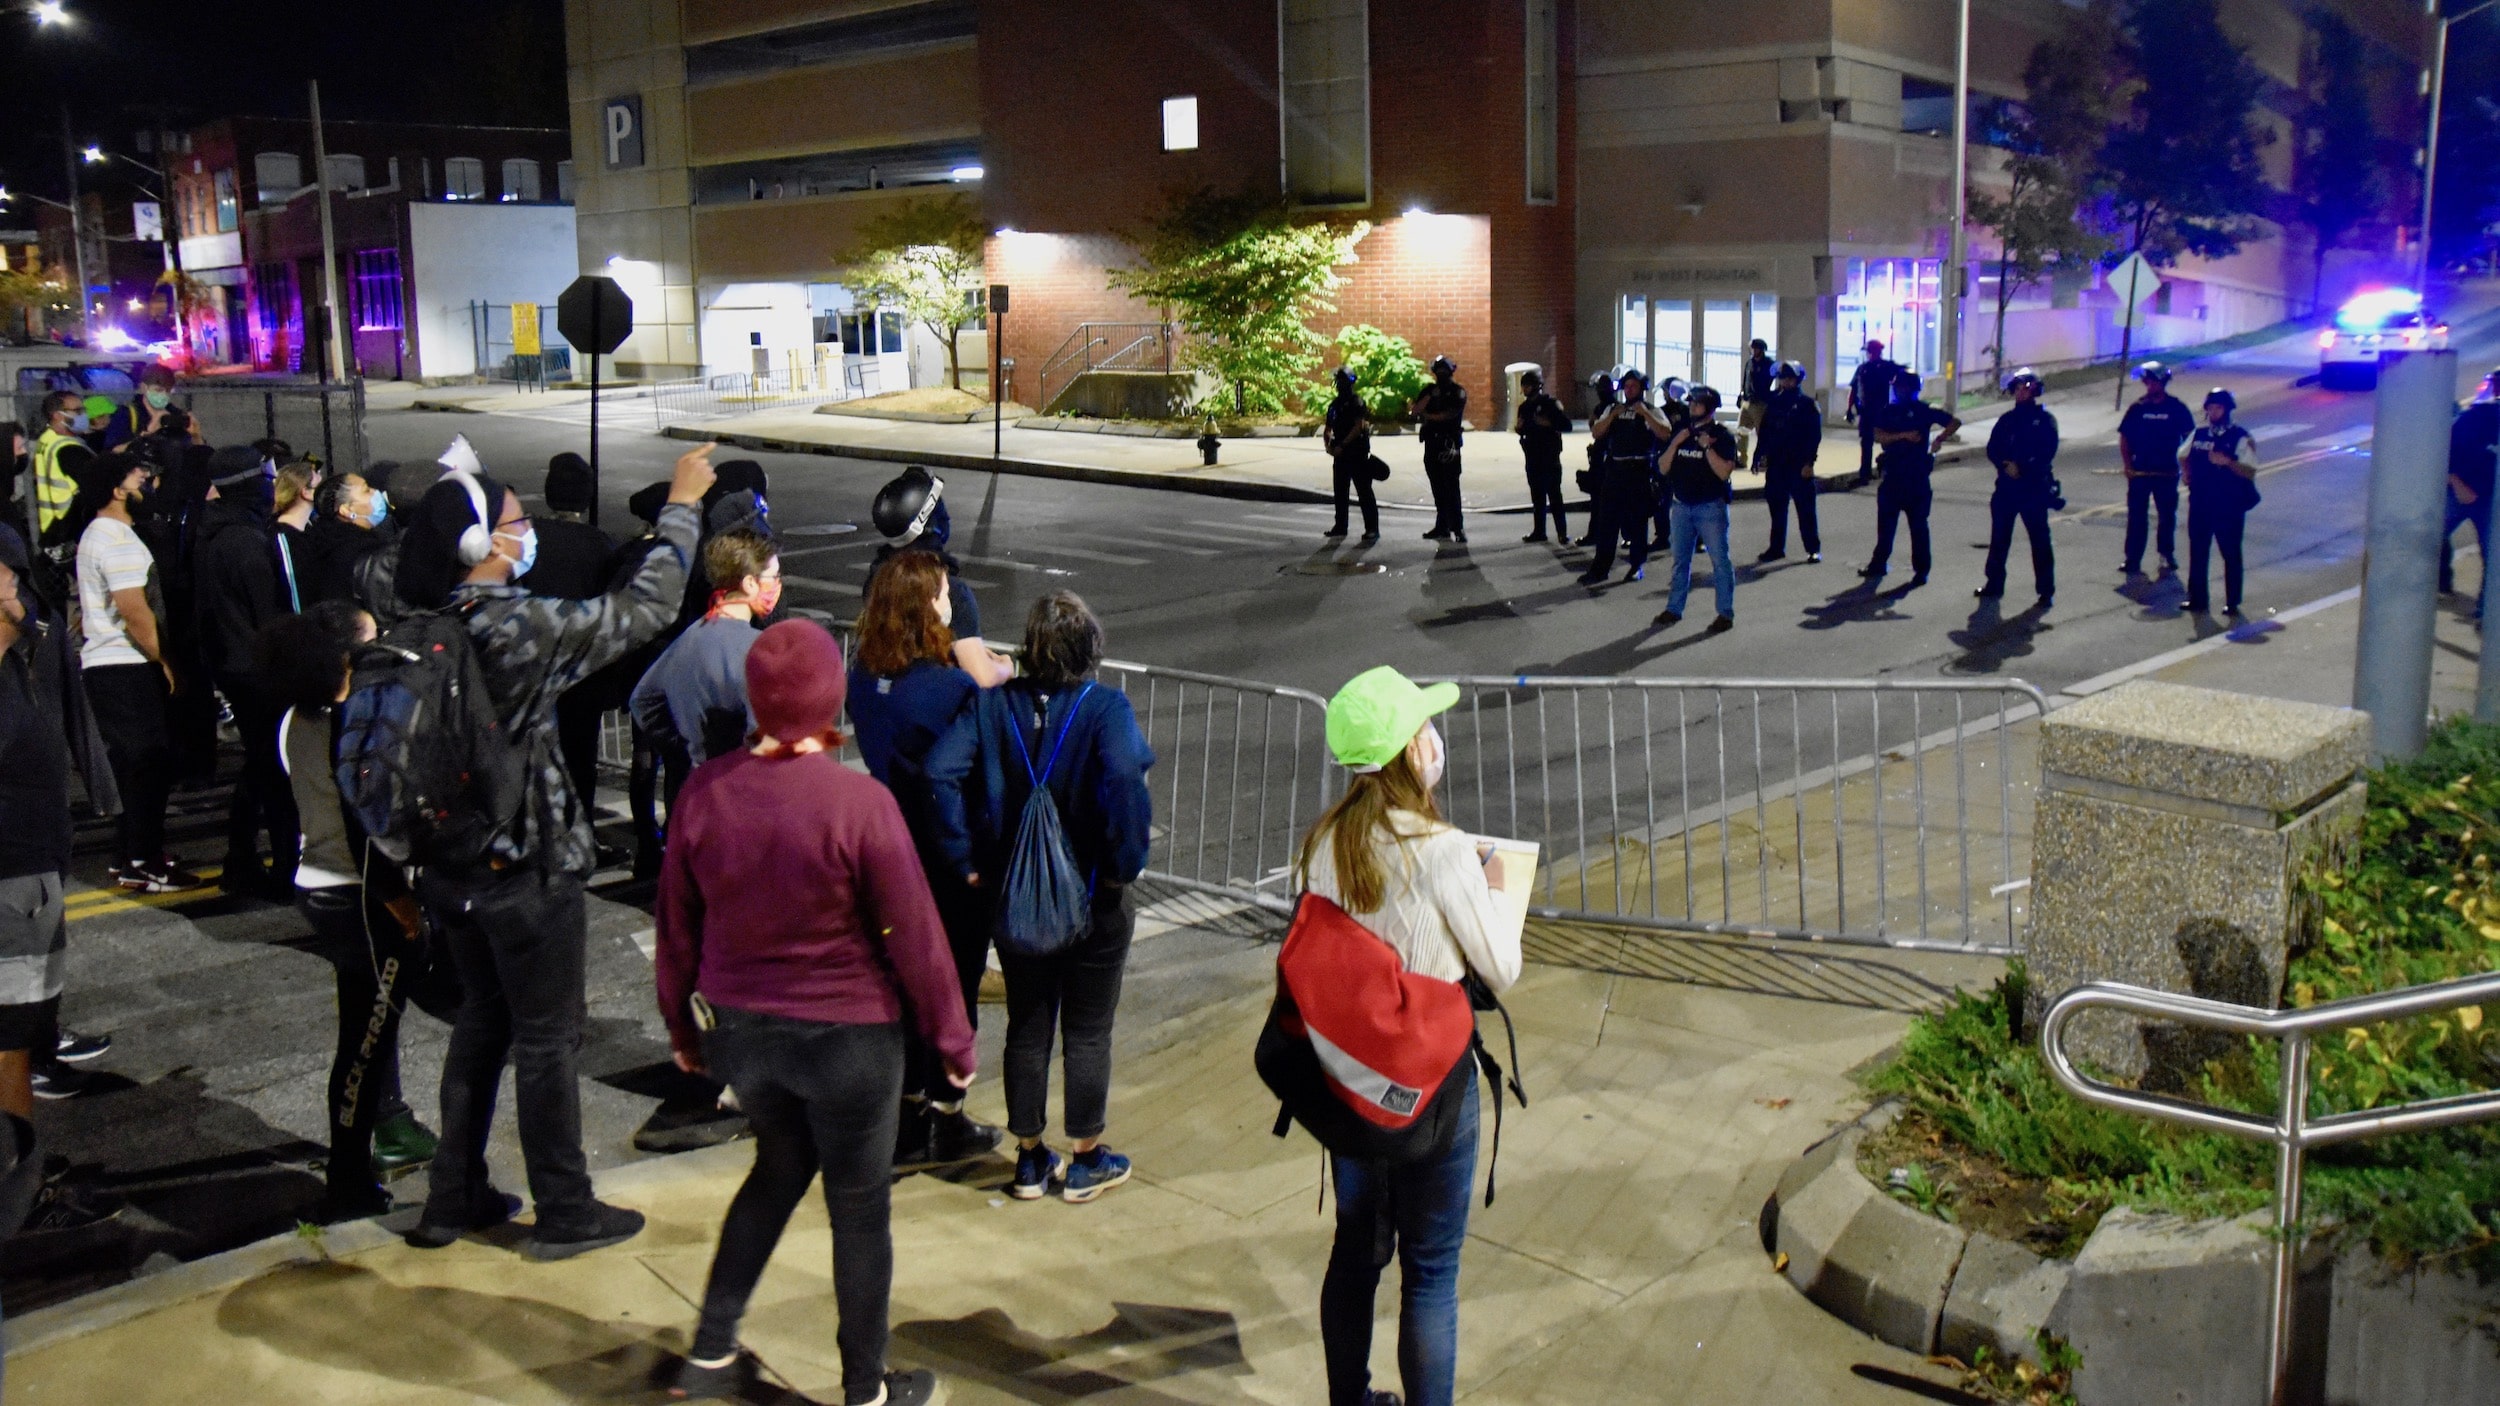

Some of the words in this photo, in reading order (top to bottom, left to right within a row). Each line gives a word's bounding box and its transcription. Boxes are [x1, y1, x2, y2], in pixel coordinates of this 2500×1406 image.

[606, 105, 633, 165] P
[1677, 449, 1704, 459] POLICE
[339, 1060, 369, 1128] BLACK
[360, 957, 400, 1059] PYRAMID
